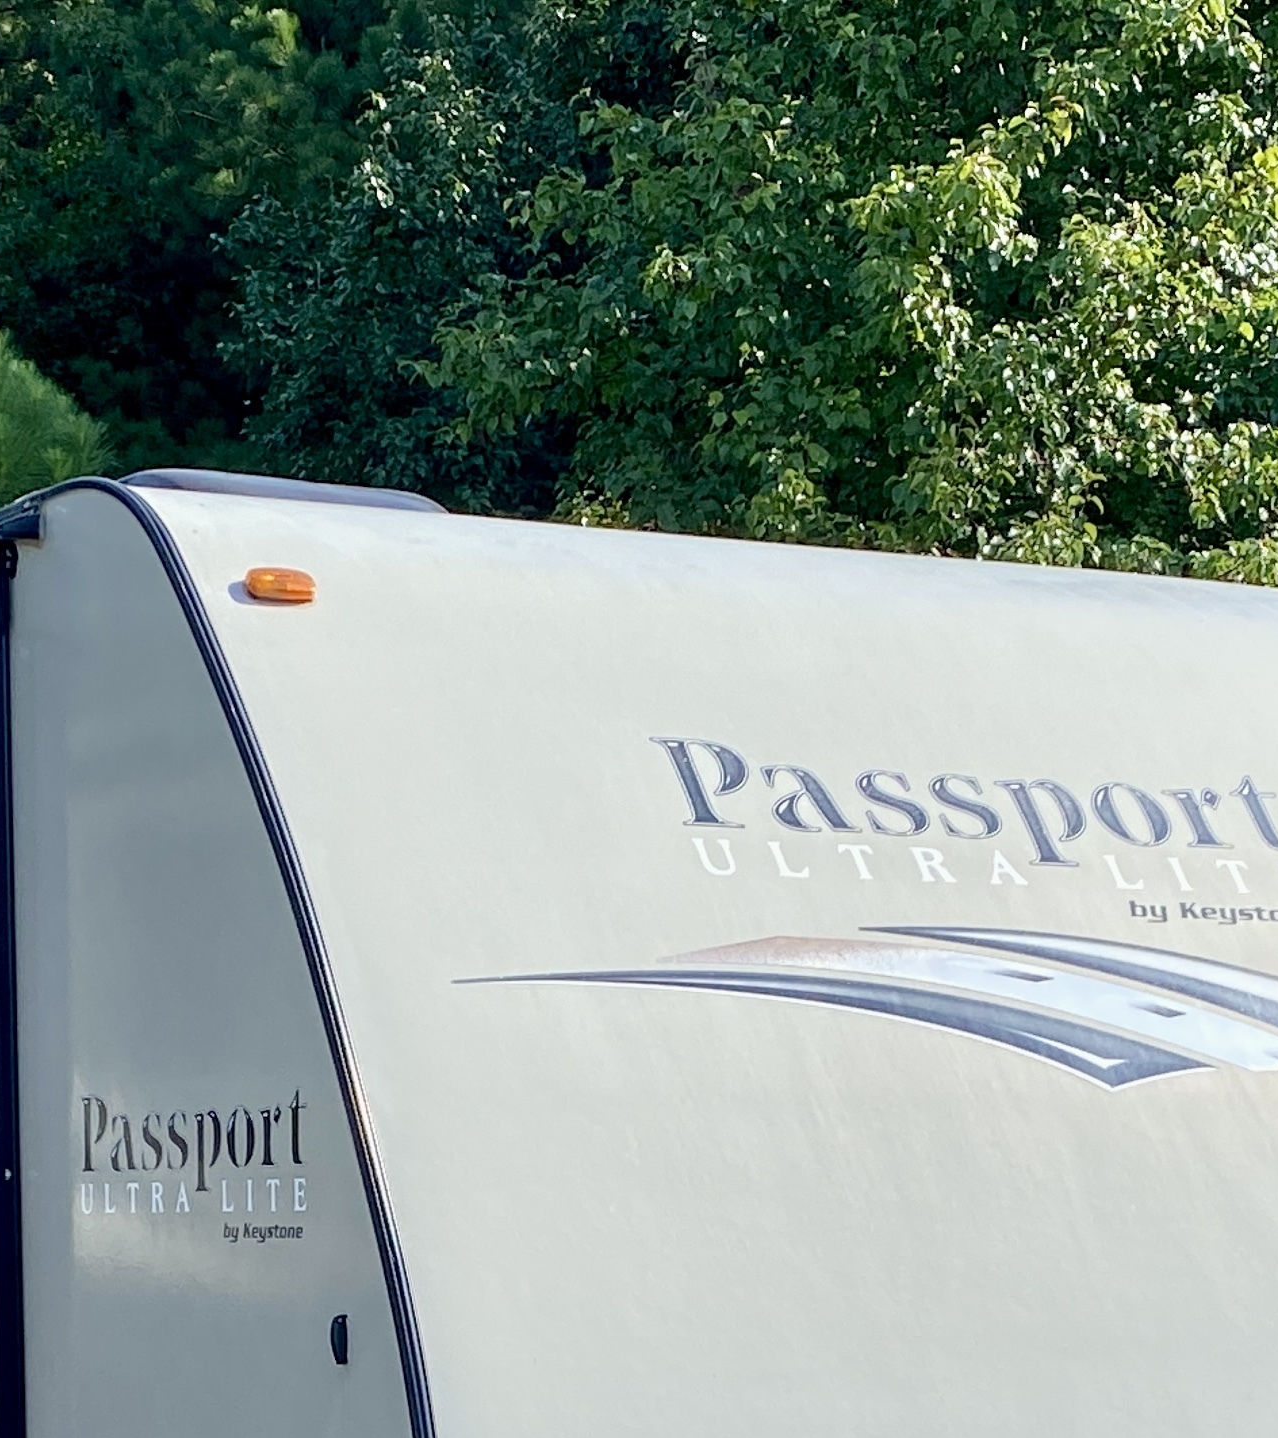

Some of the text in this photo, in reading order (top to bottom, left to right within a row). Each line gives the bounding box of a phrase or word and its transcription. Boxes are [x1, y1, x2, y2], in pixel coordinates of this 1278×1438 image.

[691, 837, 1029, 886] ULTRA
[1129, 900, 1169, 924] by
[80, 1088, 308, 1192] Passport
[80, 1177, 308, 1214] ULTRA LITE
[223, 1222, 304, 1244] by Keystone
